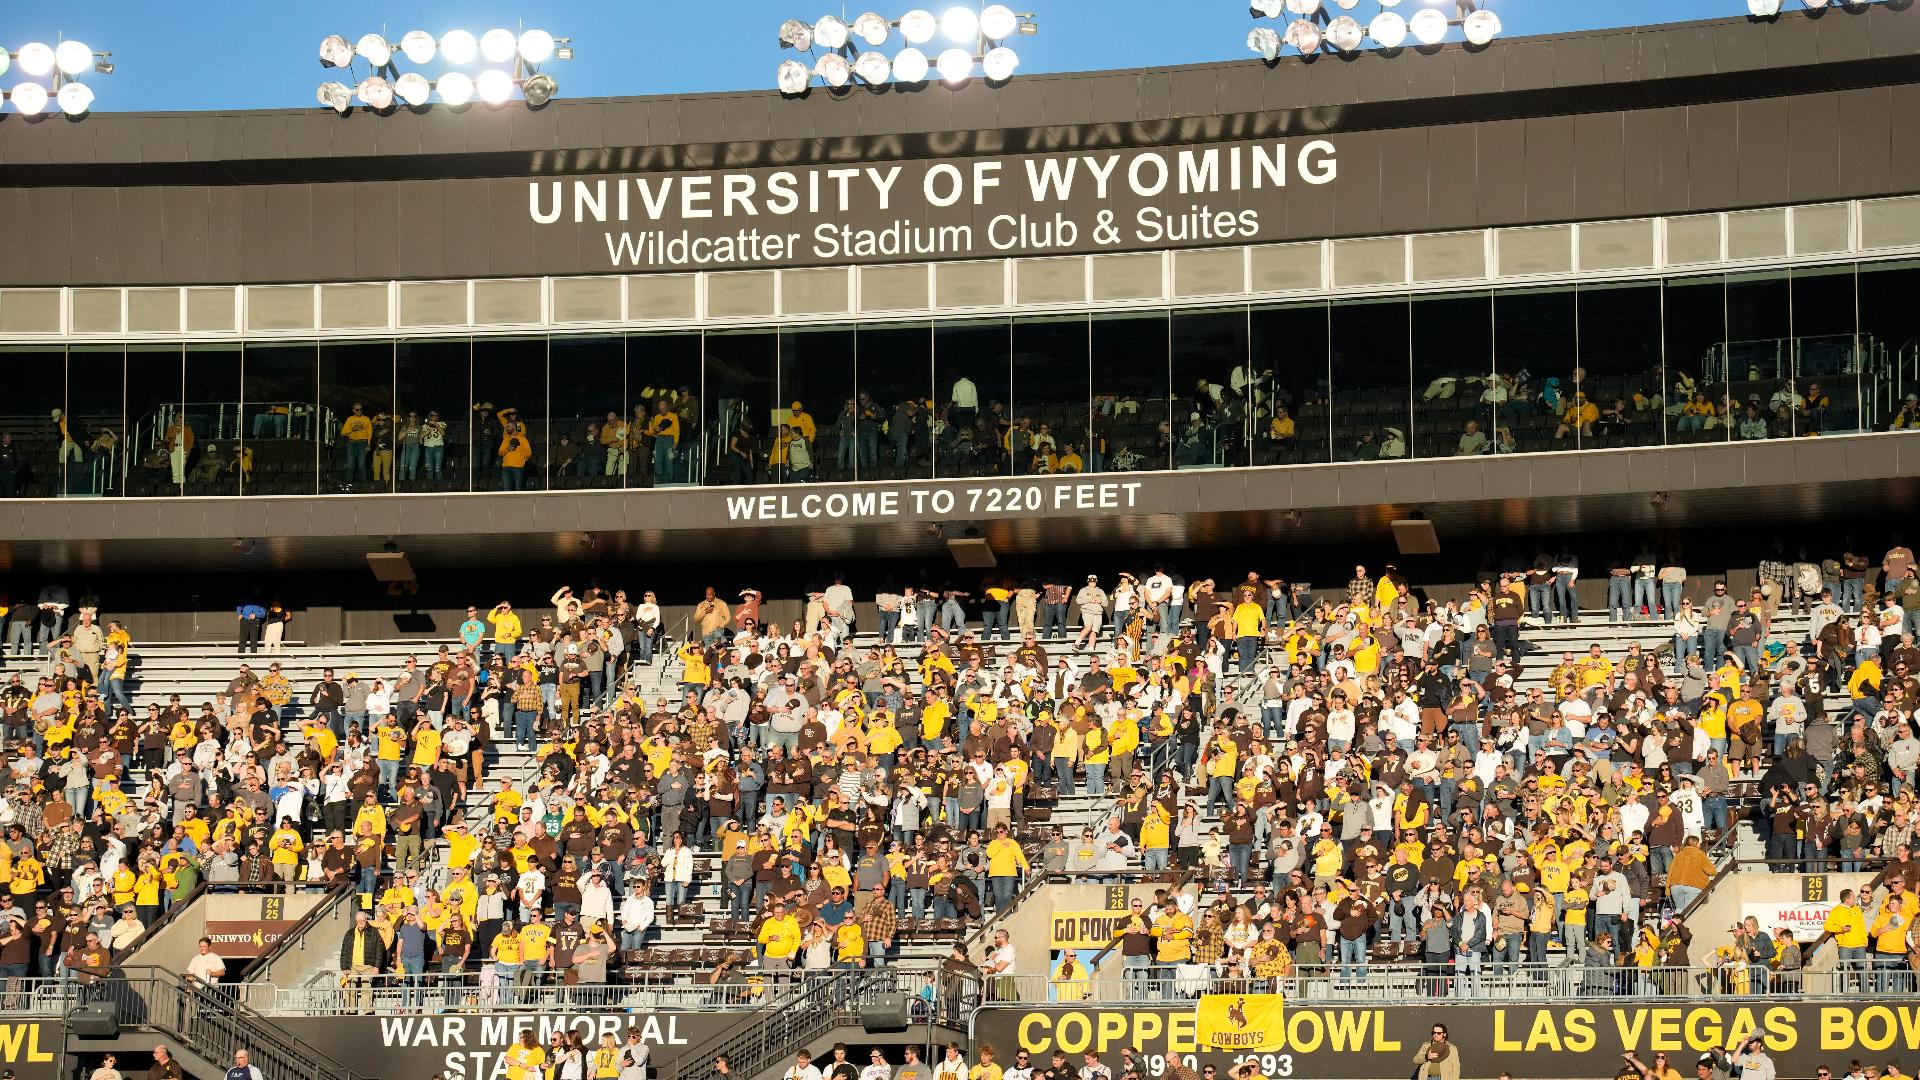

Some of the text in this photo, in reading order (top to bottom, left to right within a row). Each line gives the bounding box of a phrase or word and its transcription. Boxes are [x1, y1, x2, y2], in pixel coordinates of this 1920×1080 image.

[529, 139, 1337, 225] UNIVERSITY OF WYOMING
[605, 205, 1259, 266] Wildcatter Stadium Club & Suites
[727, 483, 1142, 520] WELCOME TO 7220 FEET
[1808, 677, 1820, 694] 5
[1808, 877, 1822, 888] 26
[1808, 890, 1822, 901] 27
[266, 898, 279, 909] 24
[1111, 899, 1124, 910] 26
[265, 909, 279, 920] 25
[1778, 910, 1831, 921] HALLAD
[1054, 917, 1121, 942] GO POK
[208, 934, 252, 943] UNIWYO
[561, 936, 578, 950] 17
[380, 1017, 467, 1047] WAR
[1018, 1010, 1402, 1054] COPPE OWL
[1493, 1008, 1597, 1053] LAS
[1612, 1006, 1798, 1052] VEGAS
[1211, 1031, 1264, 1045] COWBOYS
